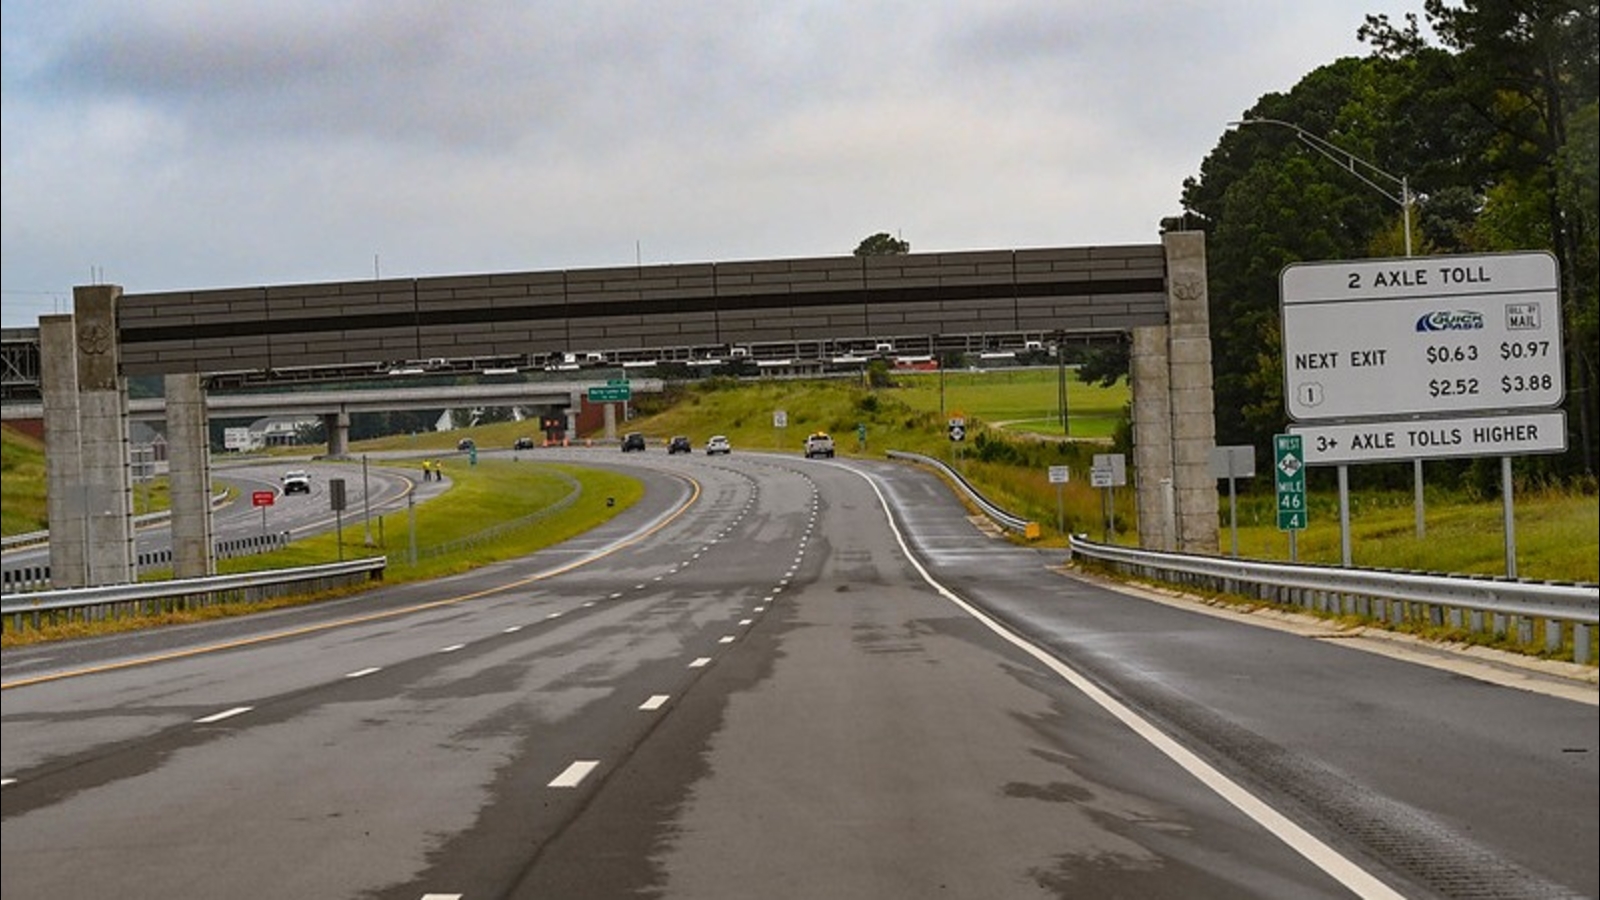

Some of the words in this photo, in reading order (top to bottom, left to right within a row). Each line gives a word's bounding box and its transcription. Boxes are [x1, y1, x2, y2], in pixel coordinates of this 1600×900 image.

[1348, 273, 1361, 289] 2
[1374, 269, 1428, 287] AXLE
[1440, 266, 1491, 284] TOLL
[1509, 315, 1536, 328] MAIL
[1295, 352, 1338, 370] NEXT
[1350, 349, 1387, 367] EXIT
[1426, 345, 1479, 365] $0.63
[1500, 341, 1550, 361] $0.97
[1428, 377, 1479, 397] $2.52
[1501, 373, 1552, 394] $3.88
[1307, 387, 1314, 403] 1
[1316, 435, 1338, 452] 3+
[1350, 431, 1395, 450] AXLE
[1408, 428, 1463, 447] TOLLS
[1473, 424, 1539, 443] HIGHER
[1279, 481, 1302, 493] MILE
[1281, 494, 1301, 509] 46
[1290, 513, 1299, 527] 4
